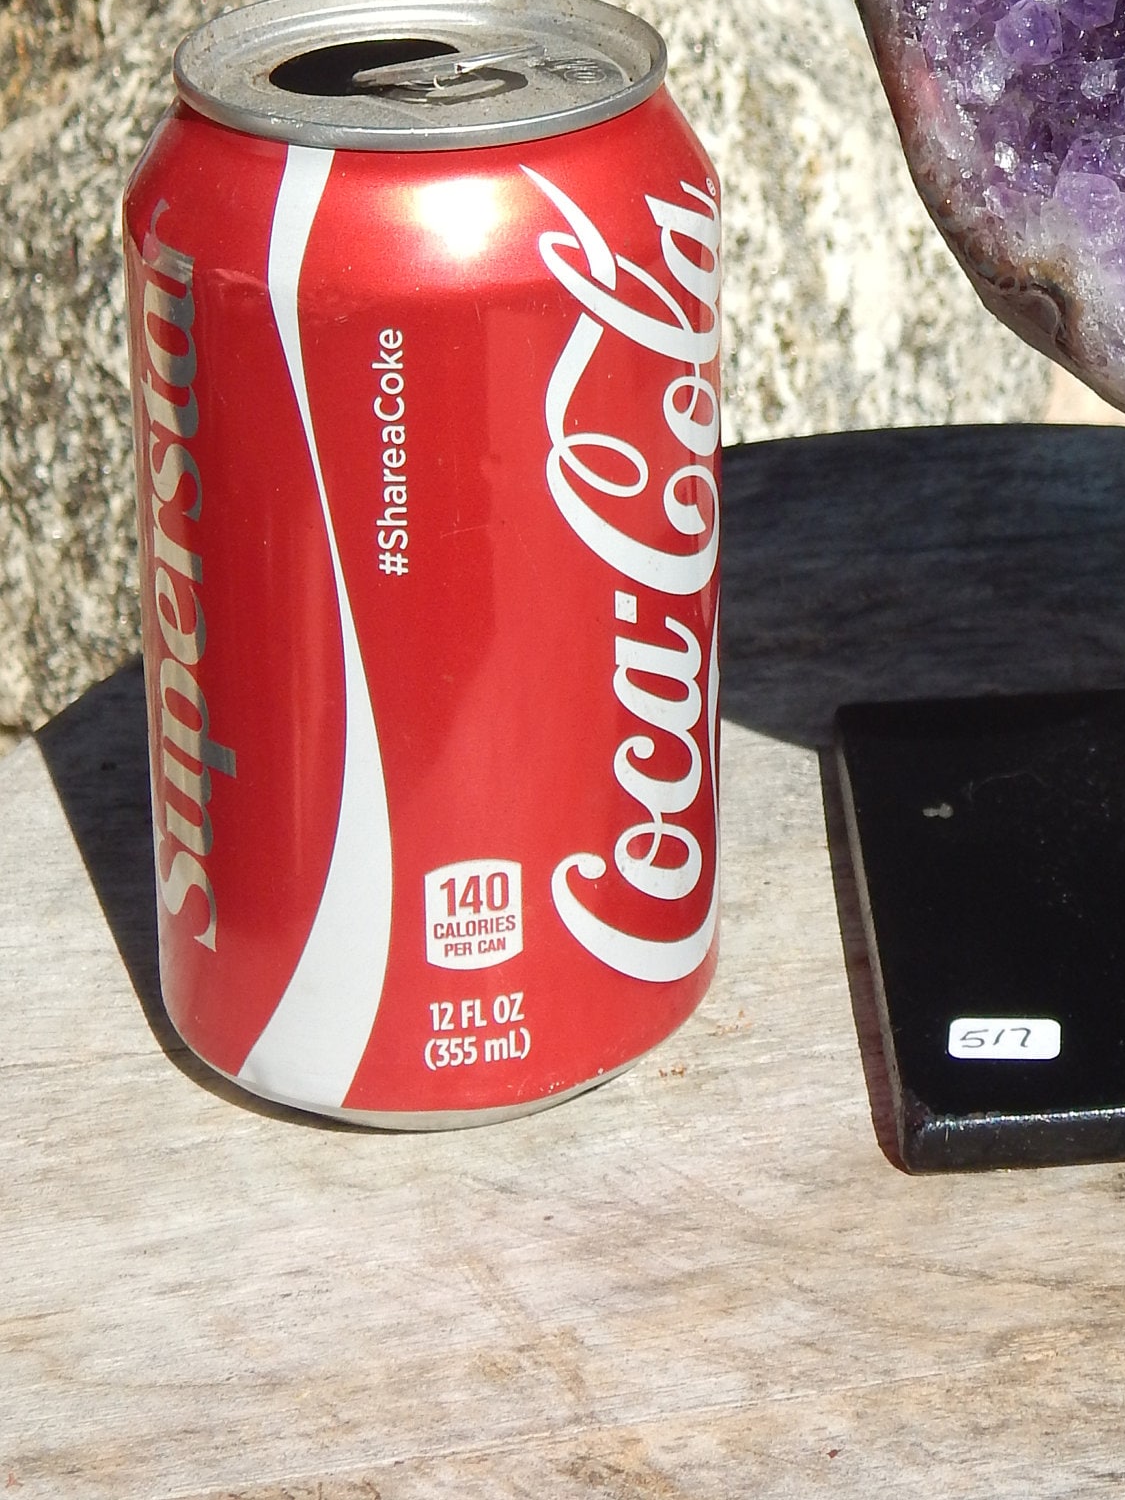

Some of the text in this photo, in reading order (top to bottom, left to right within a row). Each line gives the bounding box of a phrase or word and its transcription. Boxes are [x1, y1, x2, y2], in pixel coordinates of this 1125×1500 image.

[371, 328, 409, 576] #ShareaCoke
[140, 197, 237, 952] Superstar
[519, 163, 720, 983] Coca-Cola
[440, 871, 509, 917] 140
[433, 914, 516, 940] CALORIES
[444, 936, 506, 958] PER CAN
[429, 991, 525, 1031] 12 FL OZ
[424, 1027, 531, 1071] (355 mL)
[960, 1027, 1032, 1048] 517
